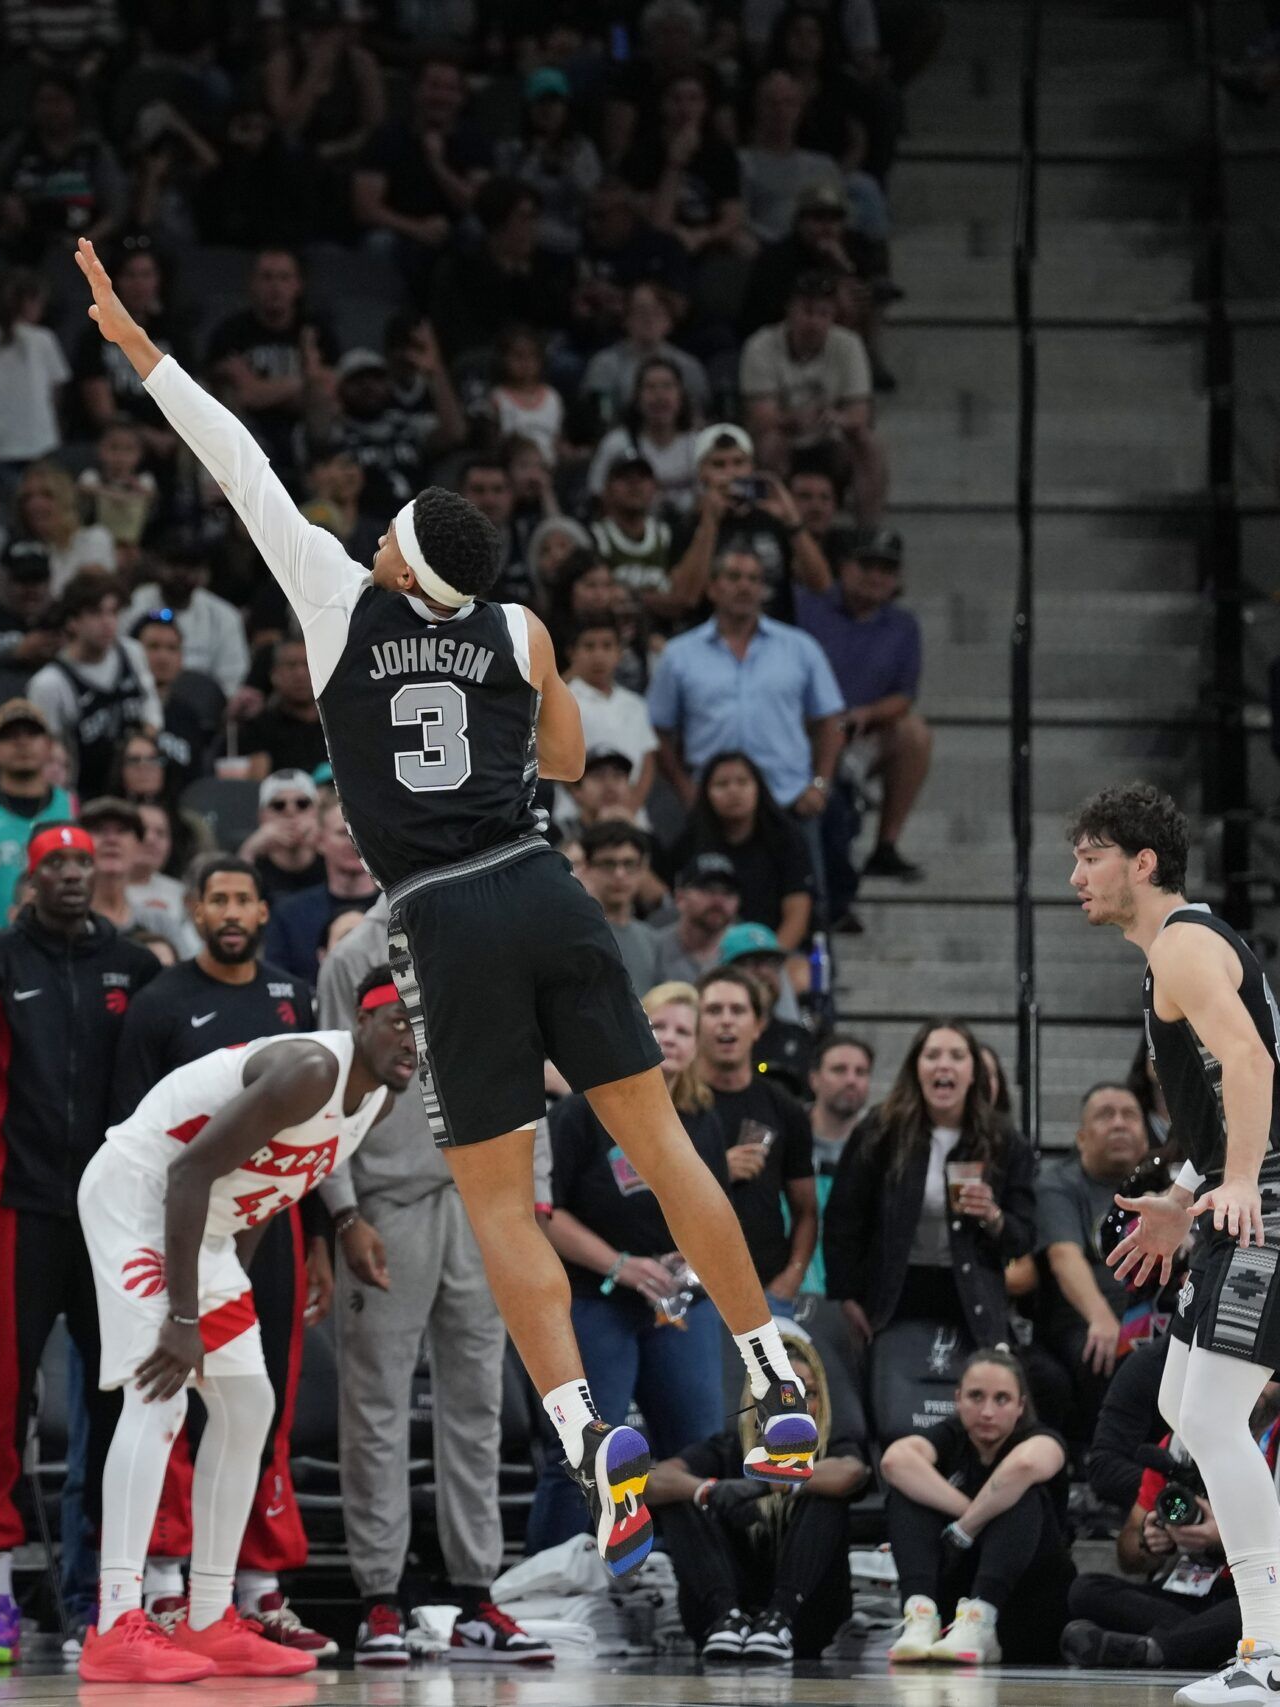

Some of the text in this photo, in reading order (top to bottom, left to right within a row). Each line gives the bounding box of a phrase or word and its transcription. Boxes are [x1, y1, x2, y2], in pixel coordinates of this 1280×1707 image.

[369, 637, 495, 684] JOHNSON
[390, 681, 472, 792] 3
[102, 971, 130, 988] IBM
[267, 982, 295, 998] IBM
